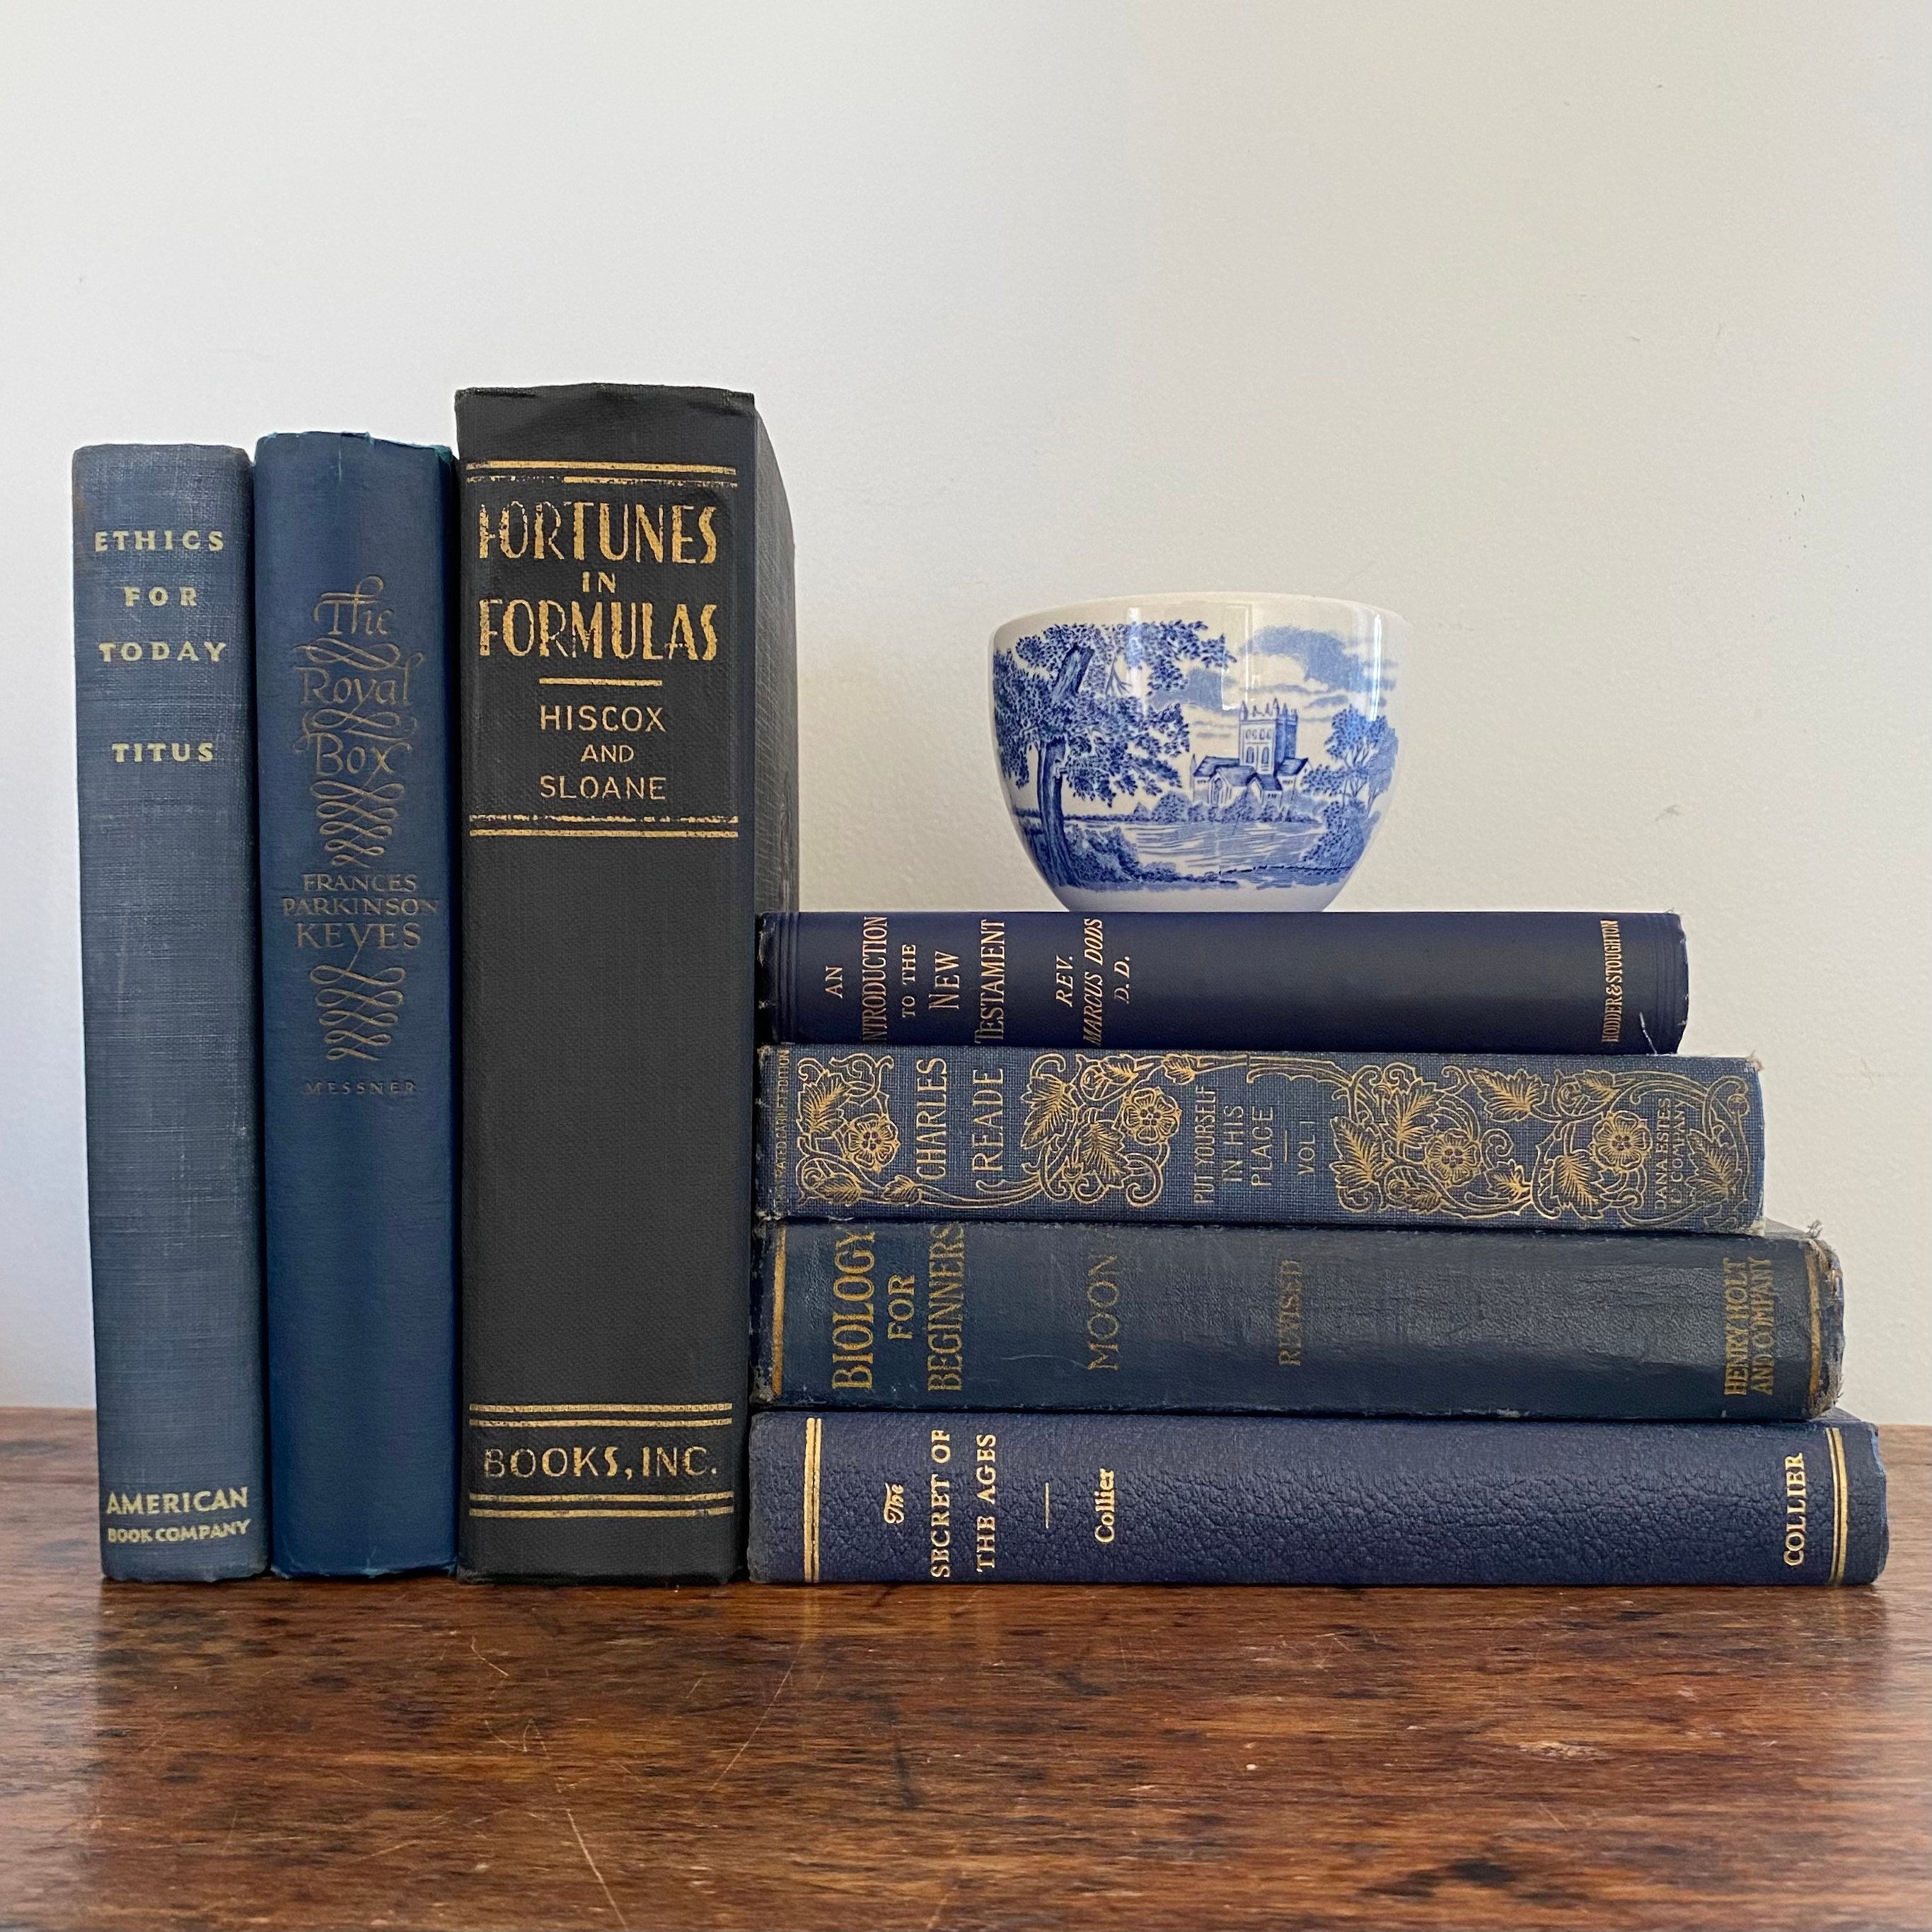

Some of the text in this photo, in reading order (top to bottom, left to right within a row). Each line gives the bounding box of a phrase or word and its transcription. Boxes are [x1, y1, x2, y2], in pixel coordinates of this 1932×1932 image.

[96, 531, 224, 552] ETHICS
[479, 501, 717, 564] FORTUNES
[123, 586, 197, 607] FOR
[314, 575, 395, 635] The
[582, 571, 616, 594] IN
[98, 641, 227, 661] TODAY
[479, 598, 718, 661] FORMULAS
[294, 652, 424, 707] Royal
[539, 704, 666, 732] HISCOX
[112, 743, 214, 762] TITUS
[293, 732, 412, 777] Box
[580, 744, 635, 763] AND
[540, 775, 666, 800] SLOANE
[282, 897, 439, 915] PARKINSON
[302, 873, 417, 892] FRANCES
[296, 922, 421, 952] KEYES
[826, 966, 843, 998] AN
[862, 915, 888, 1042] NTRODUCTION
[902, 944, 915, 1018] TO THE
[928, 951, 960, 1010] NEW
[975, 919, 1005, 1043] TESTAMENT
[1055, 956, 1073, 1007] REV.
[1083, 918, 1104, 1047] MARCUS DODS
[304, 1082, 417, 1095] MESSNER
[915, 1058, 947, 1180] CHARLES
[973, 1068, 1004, 1172] READE
[1193, 1085, 1216, 1204] PUT YOURSELF
[1222, 1105, 1244, 1183] IN HIS
[1251, 1106, 1273, 1186] PLACE
[1655, 1097, 1670, 1210] DANA ESTES
[1670, 1100, 1687, 1183] COMPANY
[832, 1228, 876, 1389] BIOLOGY
[887, 1274, 915, 1340] FOR
[927, 1222, 966, 1392] BEGINNERS
[1087, 1253, 1119, 1370] MOON
[1723, 1257, 1749, 1396] HENRY HOLT
[1747, 1256, 1774, 1396] AND COMPANY
[105, 1486, 249, 1515] AMERICAN
[107, 1518, 251, 1544] BOOK COMPANY
[883, 1482, 906, 1525] The
[930, 1428, 951, 1578] SECRET OF
[976, 1433, 996, 1573] THE AGES
[1094, 1468, 1115, 1543] Collier
[1783, 1452, 1806, 1567] COLLIER
